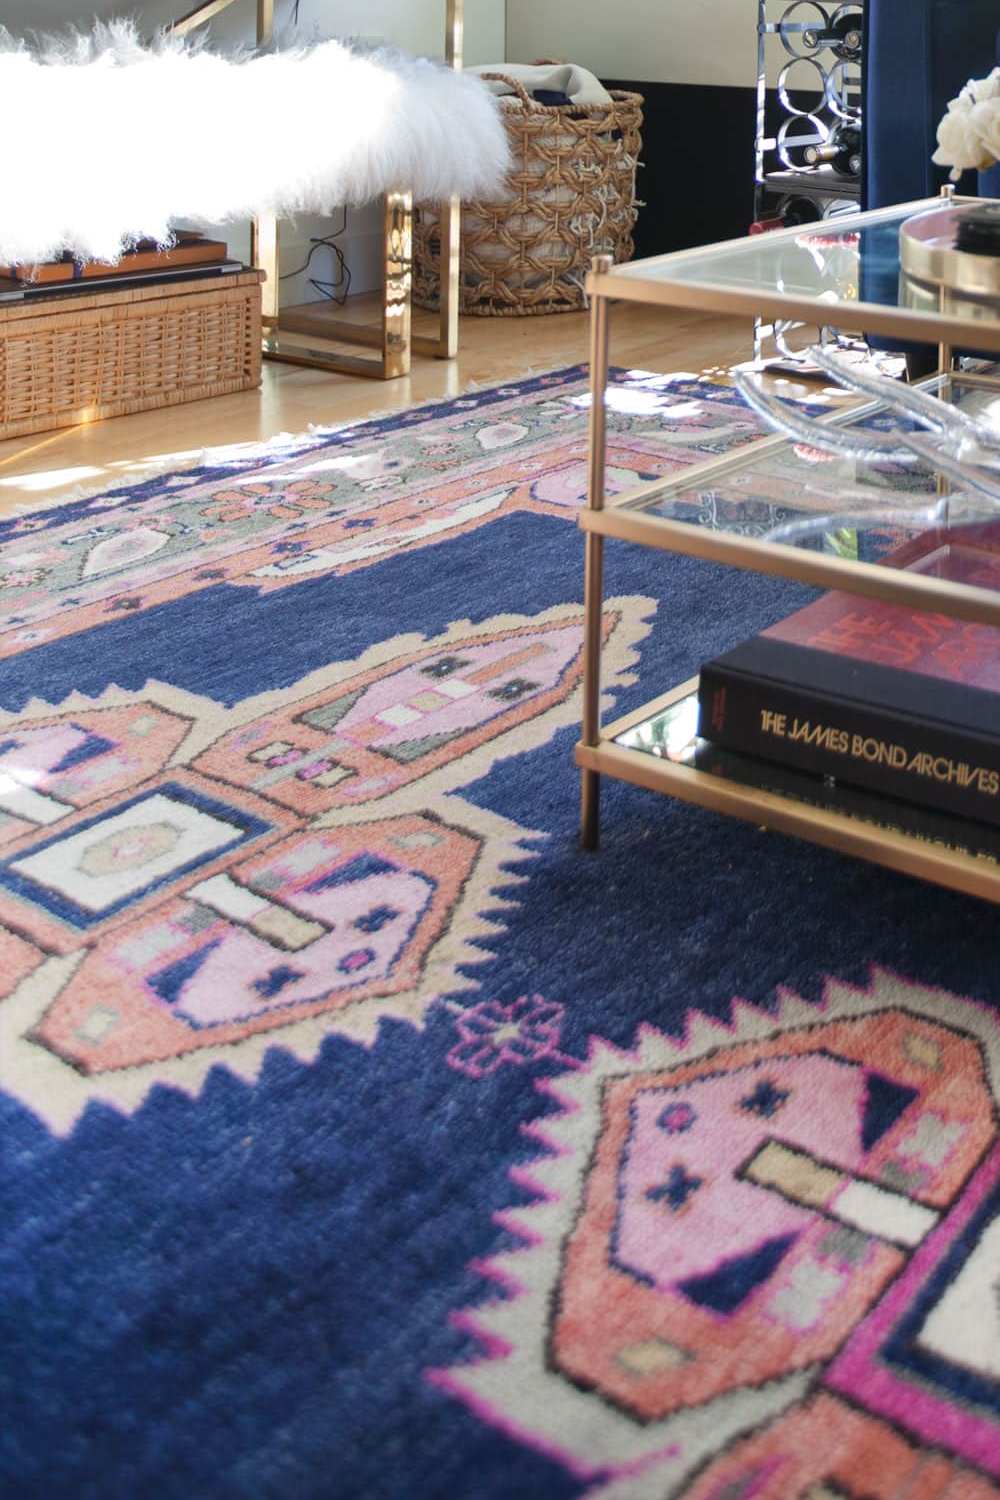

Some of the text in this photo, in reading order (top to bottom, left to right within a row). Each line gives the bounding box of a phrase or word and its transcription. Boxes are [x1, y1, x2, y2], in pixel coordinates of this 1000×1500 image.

[760, 709, 1000, 796] THE JAMES BOND ARCHIVES
